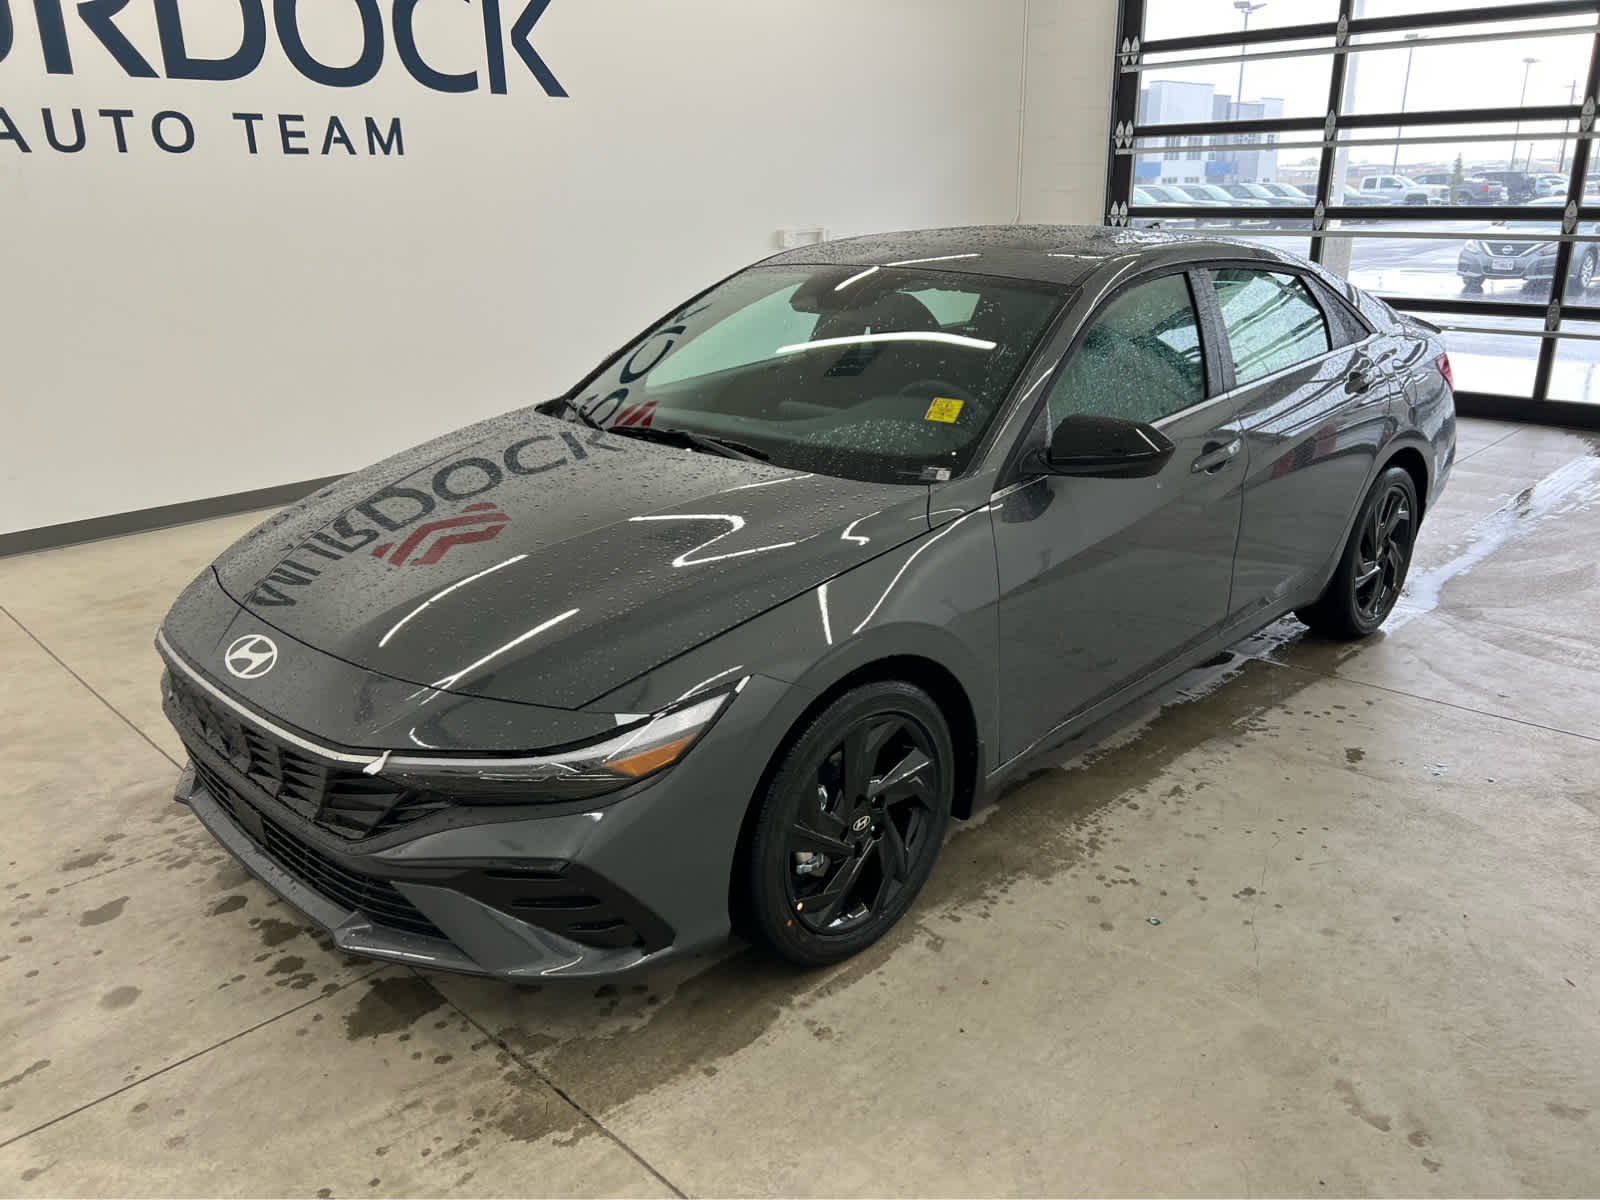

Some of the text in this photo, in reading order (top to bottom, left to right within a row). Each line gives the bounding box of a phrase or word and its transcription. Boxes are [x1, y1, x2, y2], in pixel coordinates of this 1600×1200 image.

[0, 0, 569, 97] RDOCK
[0, 107, 404, 156] AUTO TEAM
